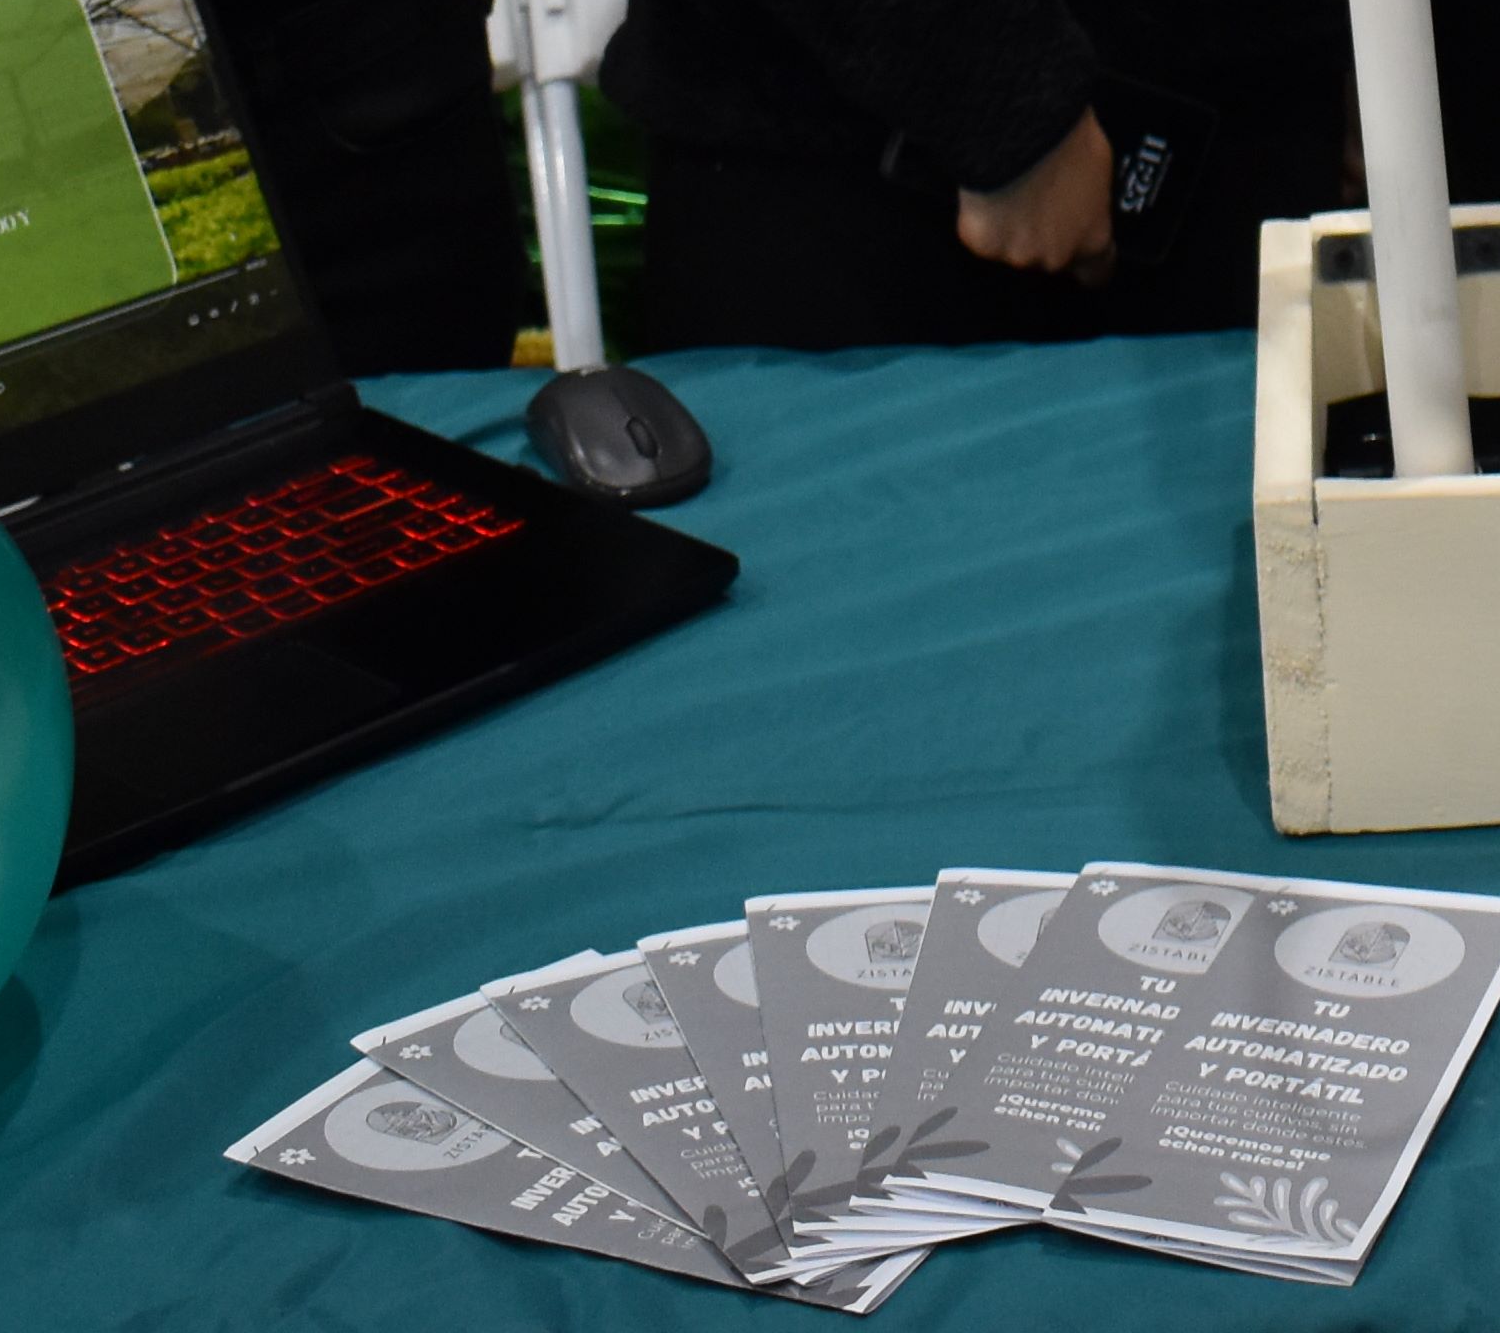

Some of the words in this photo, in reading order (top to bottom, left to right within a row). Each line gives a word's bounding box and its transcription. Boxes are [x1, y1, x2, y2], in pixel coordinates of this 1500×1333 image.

[15, 209, 31, 227] Y
[1128, 943, 1209, 963] ZISTABL
[1140, 975, 1177, 993] TU
[1303, 966, 1398, 987] ZISTABLE
[944, 1000, 997, 1016] INV
[1039, 988, 1181, 1019] INVERNAD
[1314, 1001, 1350, 1018] TU
[807, 1021, 900, 1037] INVER
[1014, 1010, 1165, 1044] AUTOMATI
[1211, 1012, 1410, 1055] INVERNADERO
[1031, 1035, 1049, 1049] Y
[950, 1049, 966, 1063] Y
[1185, 1035, 1408, 1082] AUTOMATIZADO
[830, 1070, 849, 1083] Y
[990, 1065, 1034, 1077] para
[1041, 1072, 1070, 1083] tus
[997, 1053, 1079, 1072] Cuidado
[1085, 1066, 1135, 1084] inteli
[984, 1076, 1070, 1096] importar
[1077, 1090, 1119, 1105] don
[1199, 1062, 1218, 1077] Y
[1225, 1067, 1364, 1104] PORTÁTIL
[643, 1099, 715, 1127] AUTO
[817, 1103, 863, 1112] para
[1000, 1093, 1106, 1120] ¡Queremo
[1165, 1081, 1247, 1103] Cuidado
[1253, 1097, 1361, 1122] inteligente
[818, 1113, 870, 1124] impo
[994, 1106, 1060, 1124] echen
[1151, 1104, 1235, 1127] importar
[1243, 1122, 1307, 1139] donde
[1157, 1093, 1201, 1109] para
[1208, 1101, 1238, 1114] tus
[1329, 1123, 1358, 1136] sin
[682, 1126, 701, 1140] Y
[1164, 1126, 1283, 1154] ¡Queremos
[1290, 1146, 1331, 1161] que
[1159, 1138, 1224, 1157] echen
[1231, 1149, 1305, 1171] raíces!
[552, 1185, 609, 1227] AUTO
